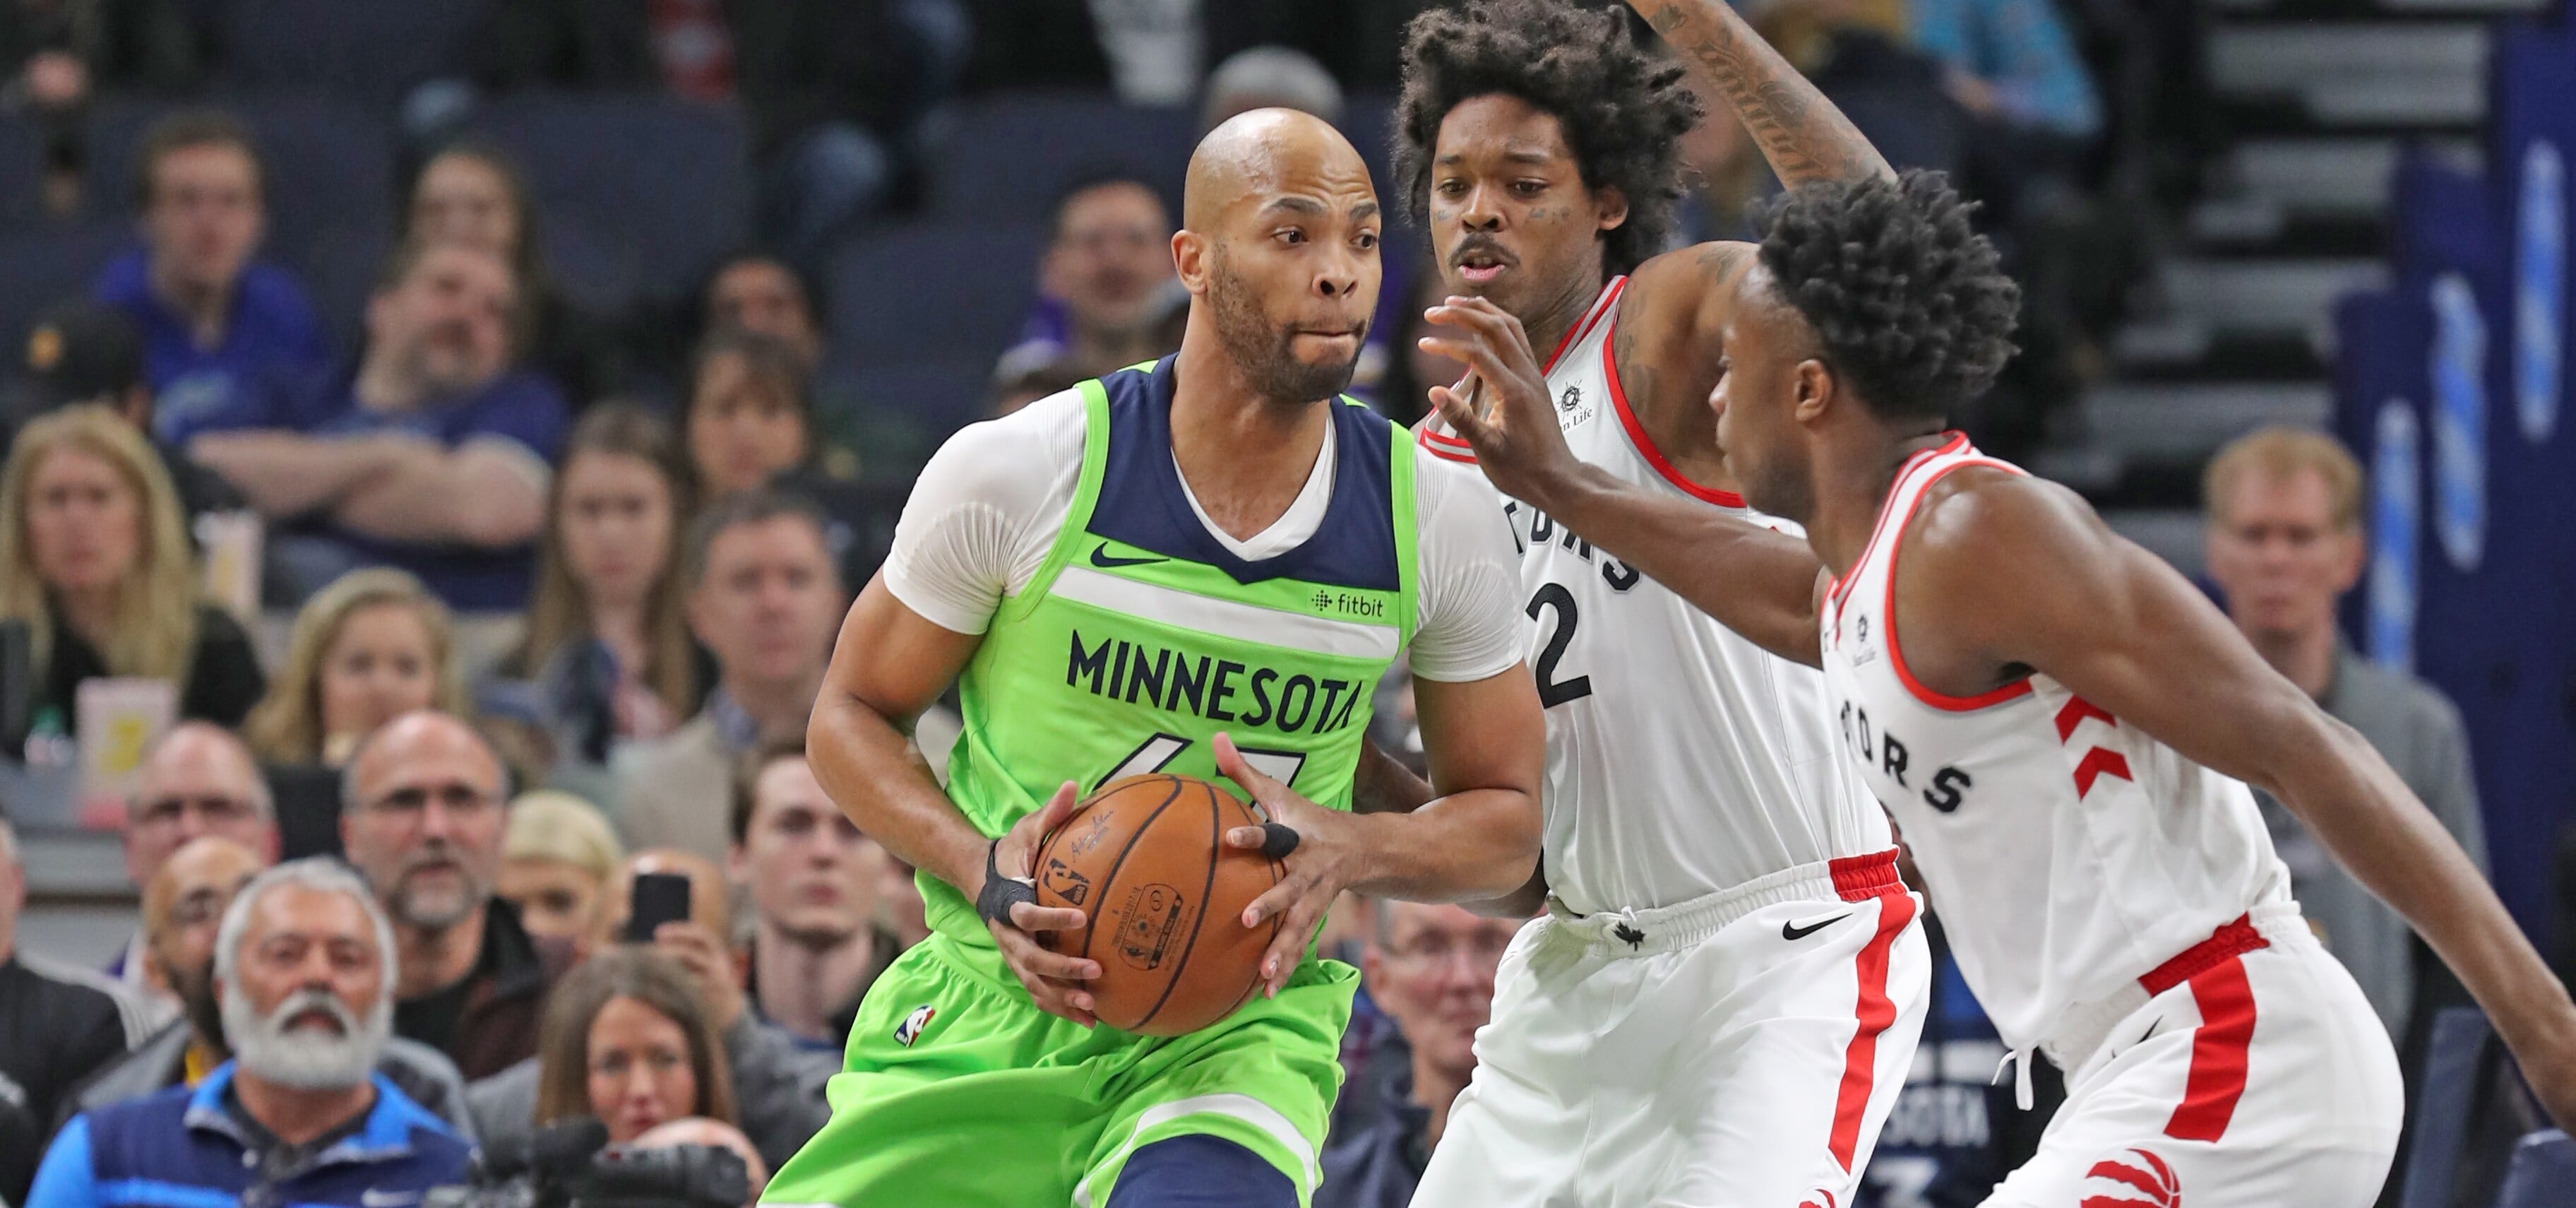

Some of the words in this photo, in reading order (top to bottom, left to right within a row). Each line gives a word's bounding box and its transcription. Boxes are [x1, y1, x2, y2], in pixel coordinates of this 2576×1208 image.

[1573, 408, 1592, 426] Life
[1338, 593, 1383, 617] fitbit
[1525, 583, 1592, 710] 2
[1067, 629, 1363, 735] MINNESOTA
